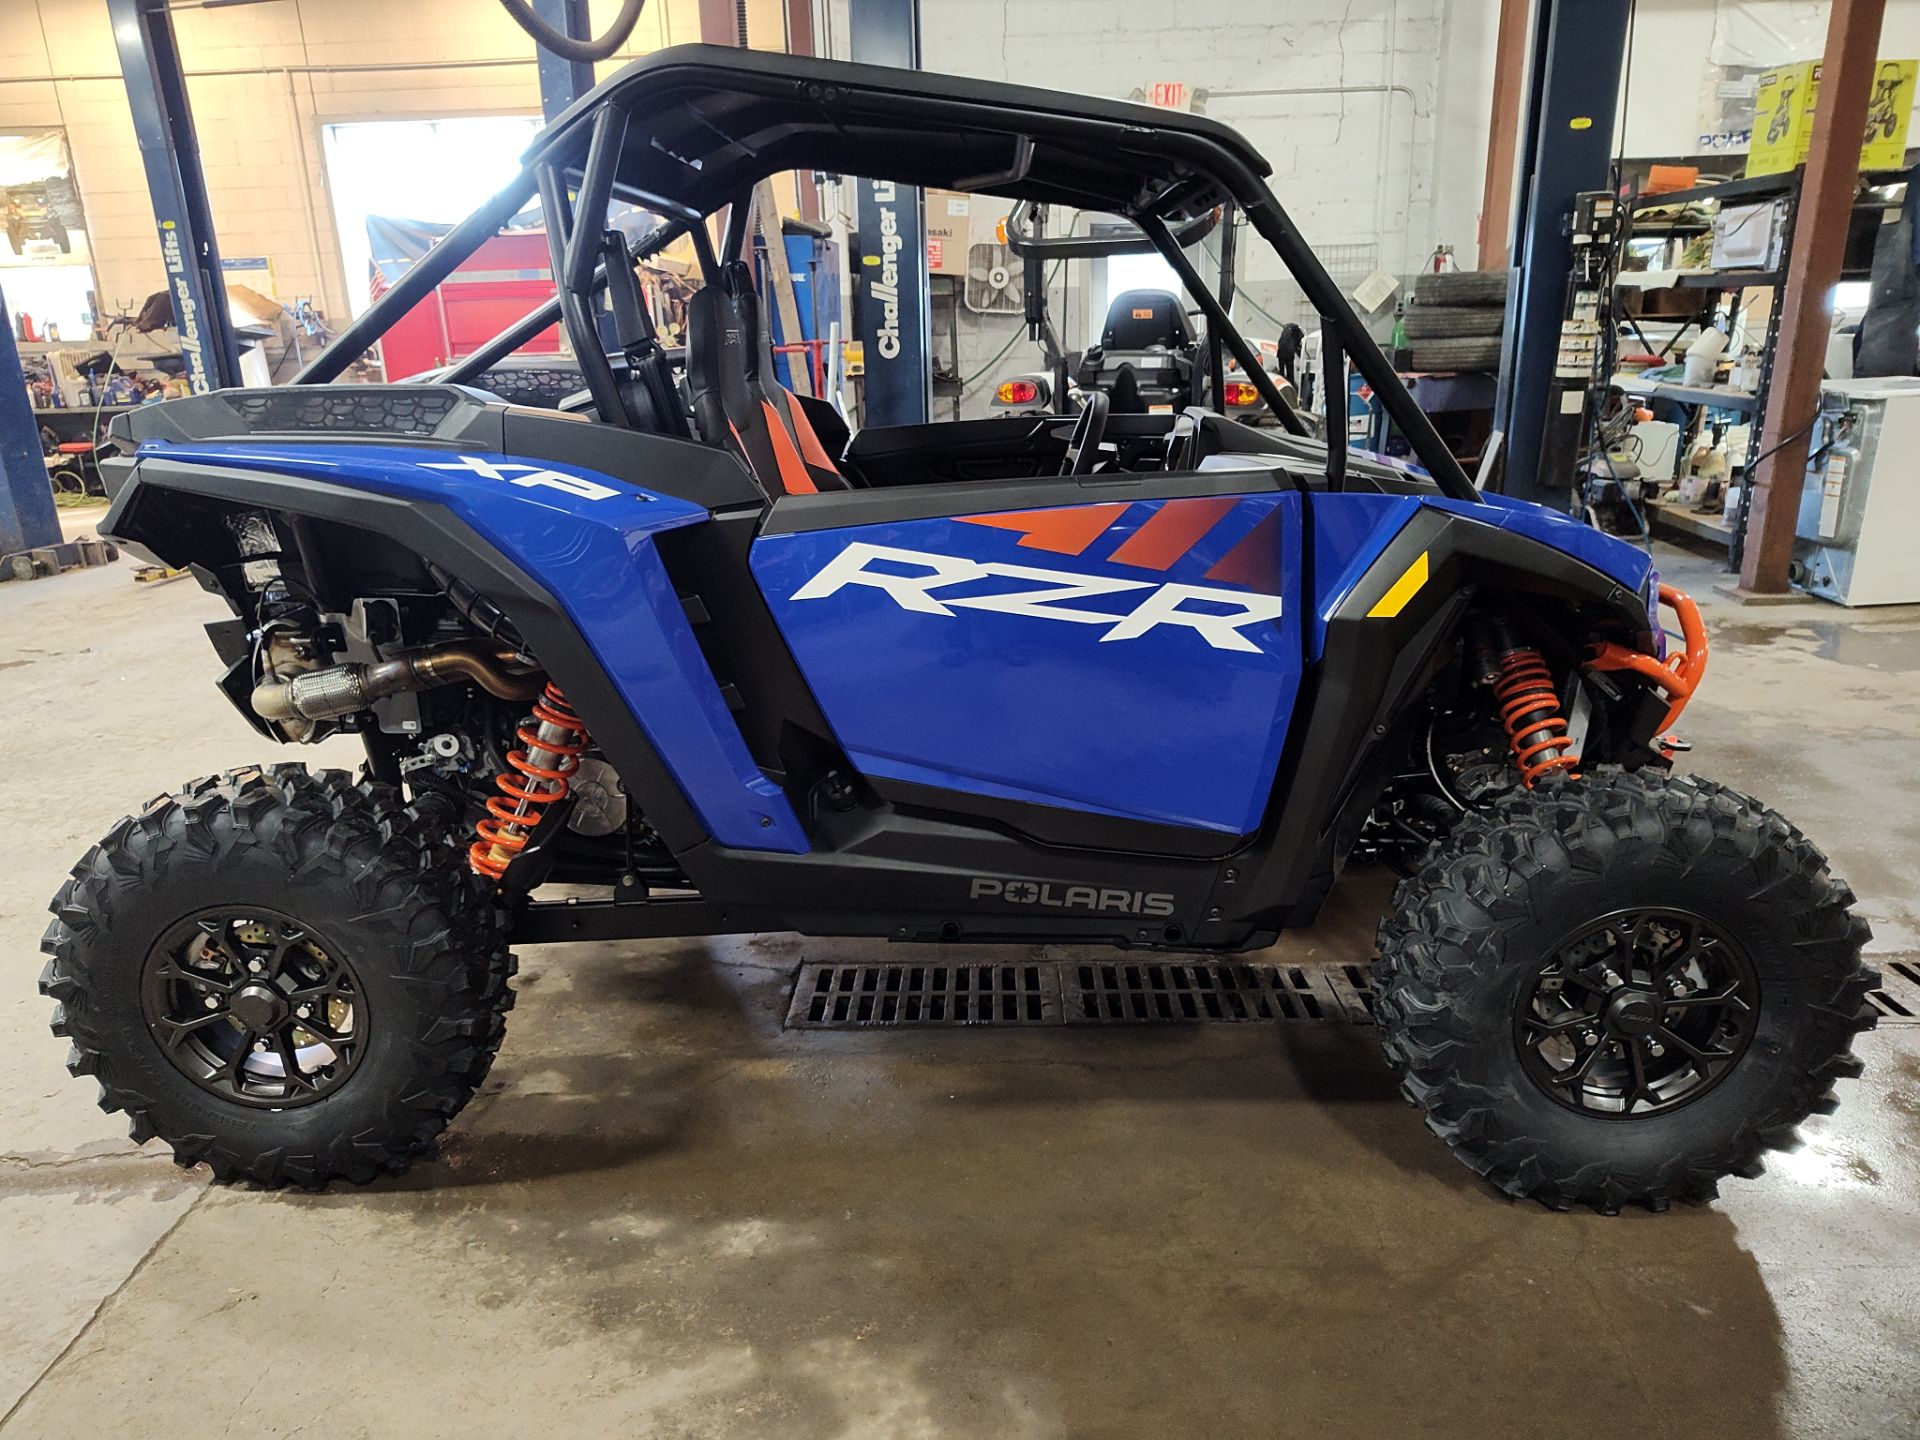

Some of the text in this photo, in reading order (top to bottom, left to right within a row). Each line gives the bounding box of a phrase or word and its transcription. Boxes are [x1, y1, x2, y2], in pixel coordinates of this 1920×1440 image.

[1155, 83, 1184, 106] EXIT
[164, 231, 210, 395] Challenger Lifts
[870, 207, 903, 359] Challenger
[416, 456, 622, 501] XP
[789, 542, 1282, 654] RZR
[970, 878, 1175, 916] POLARIS
